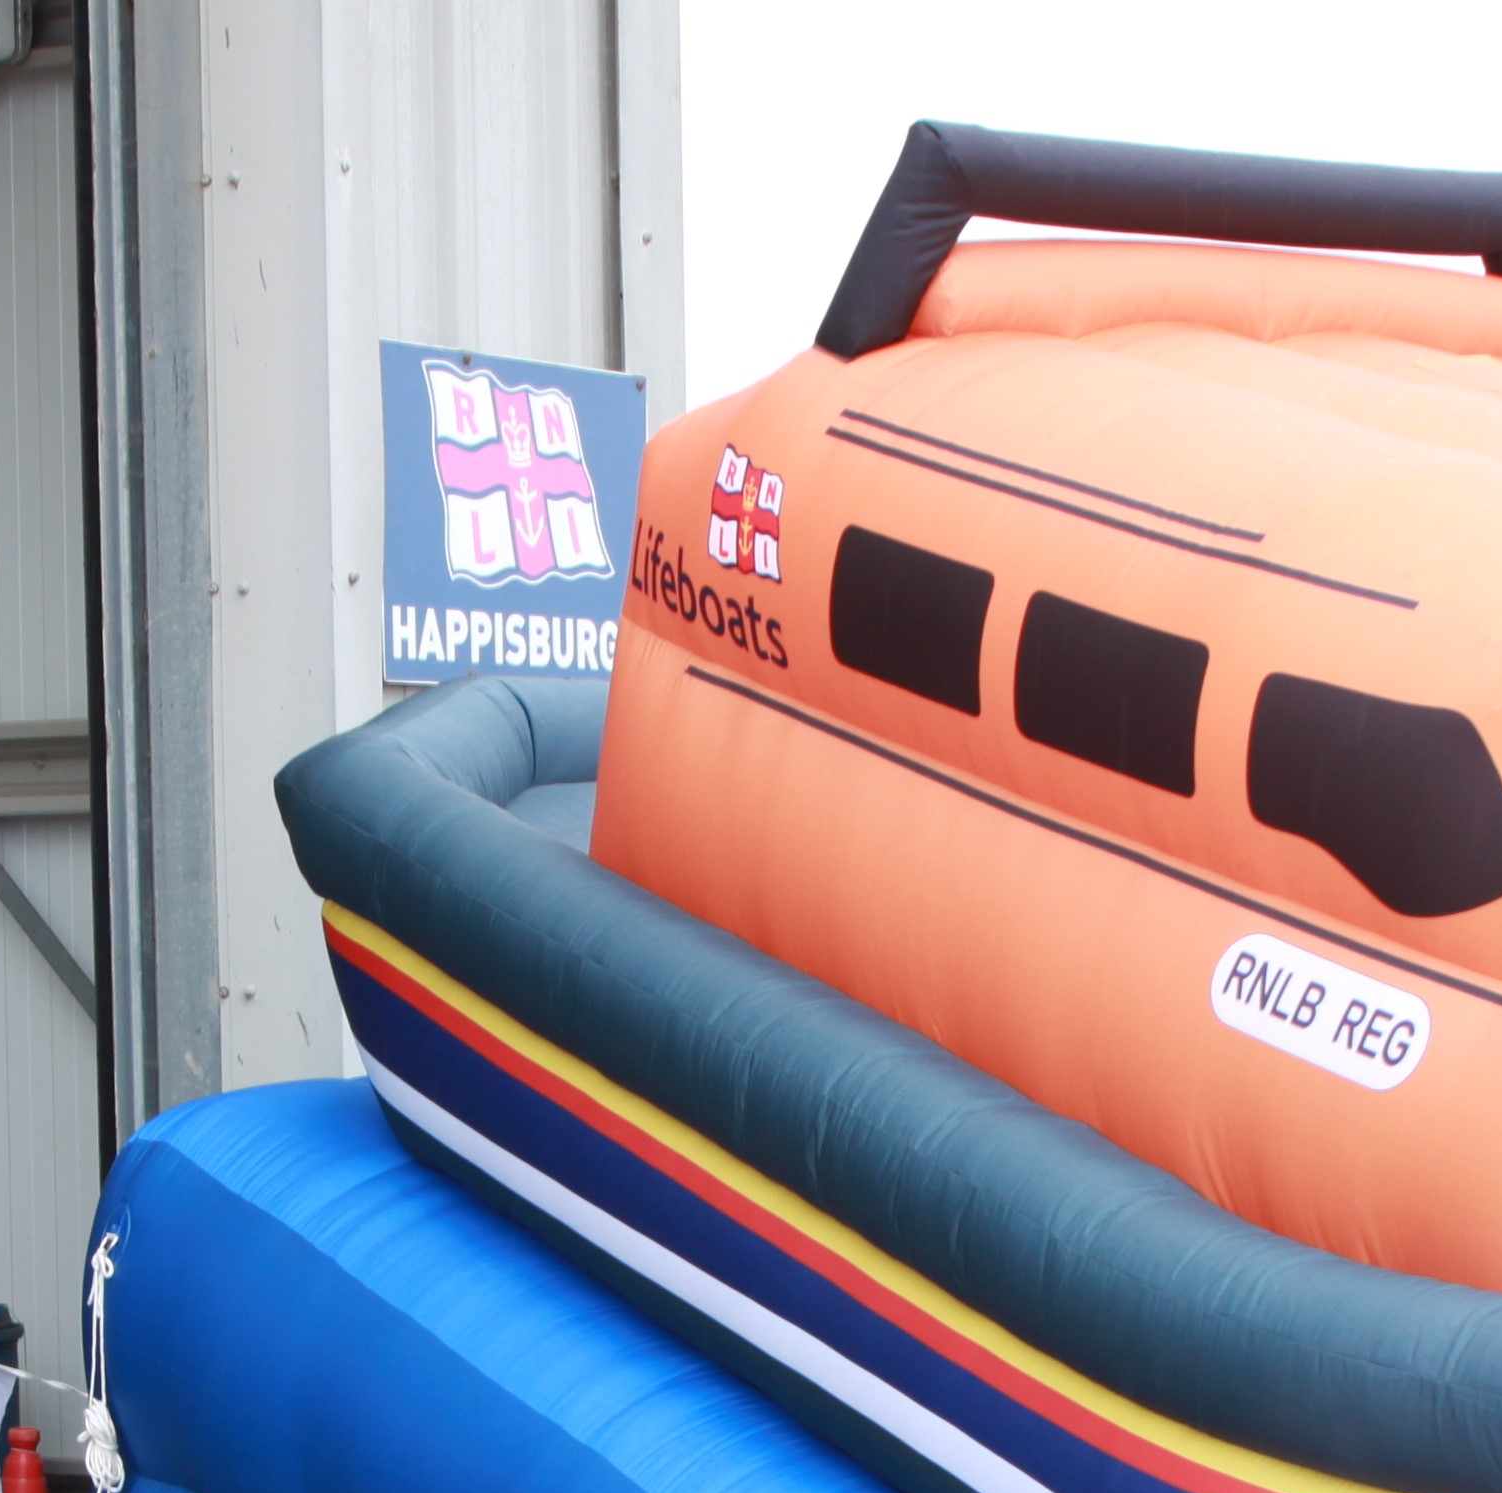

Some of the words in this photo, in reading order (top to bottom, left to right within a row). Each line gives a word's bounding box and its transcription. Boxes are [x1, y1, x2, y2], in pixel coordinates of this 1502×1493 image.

[391, 604, 618, 672] HAPPISBURG
[630, 517, 790, 669] Lifeboats
[1221, 950, 1327, 1030] RNLB
[1331, 998, 1417, 1068] REG
